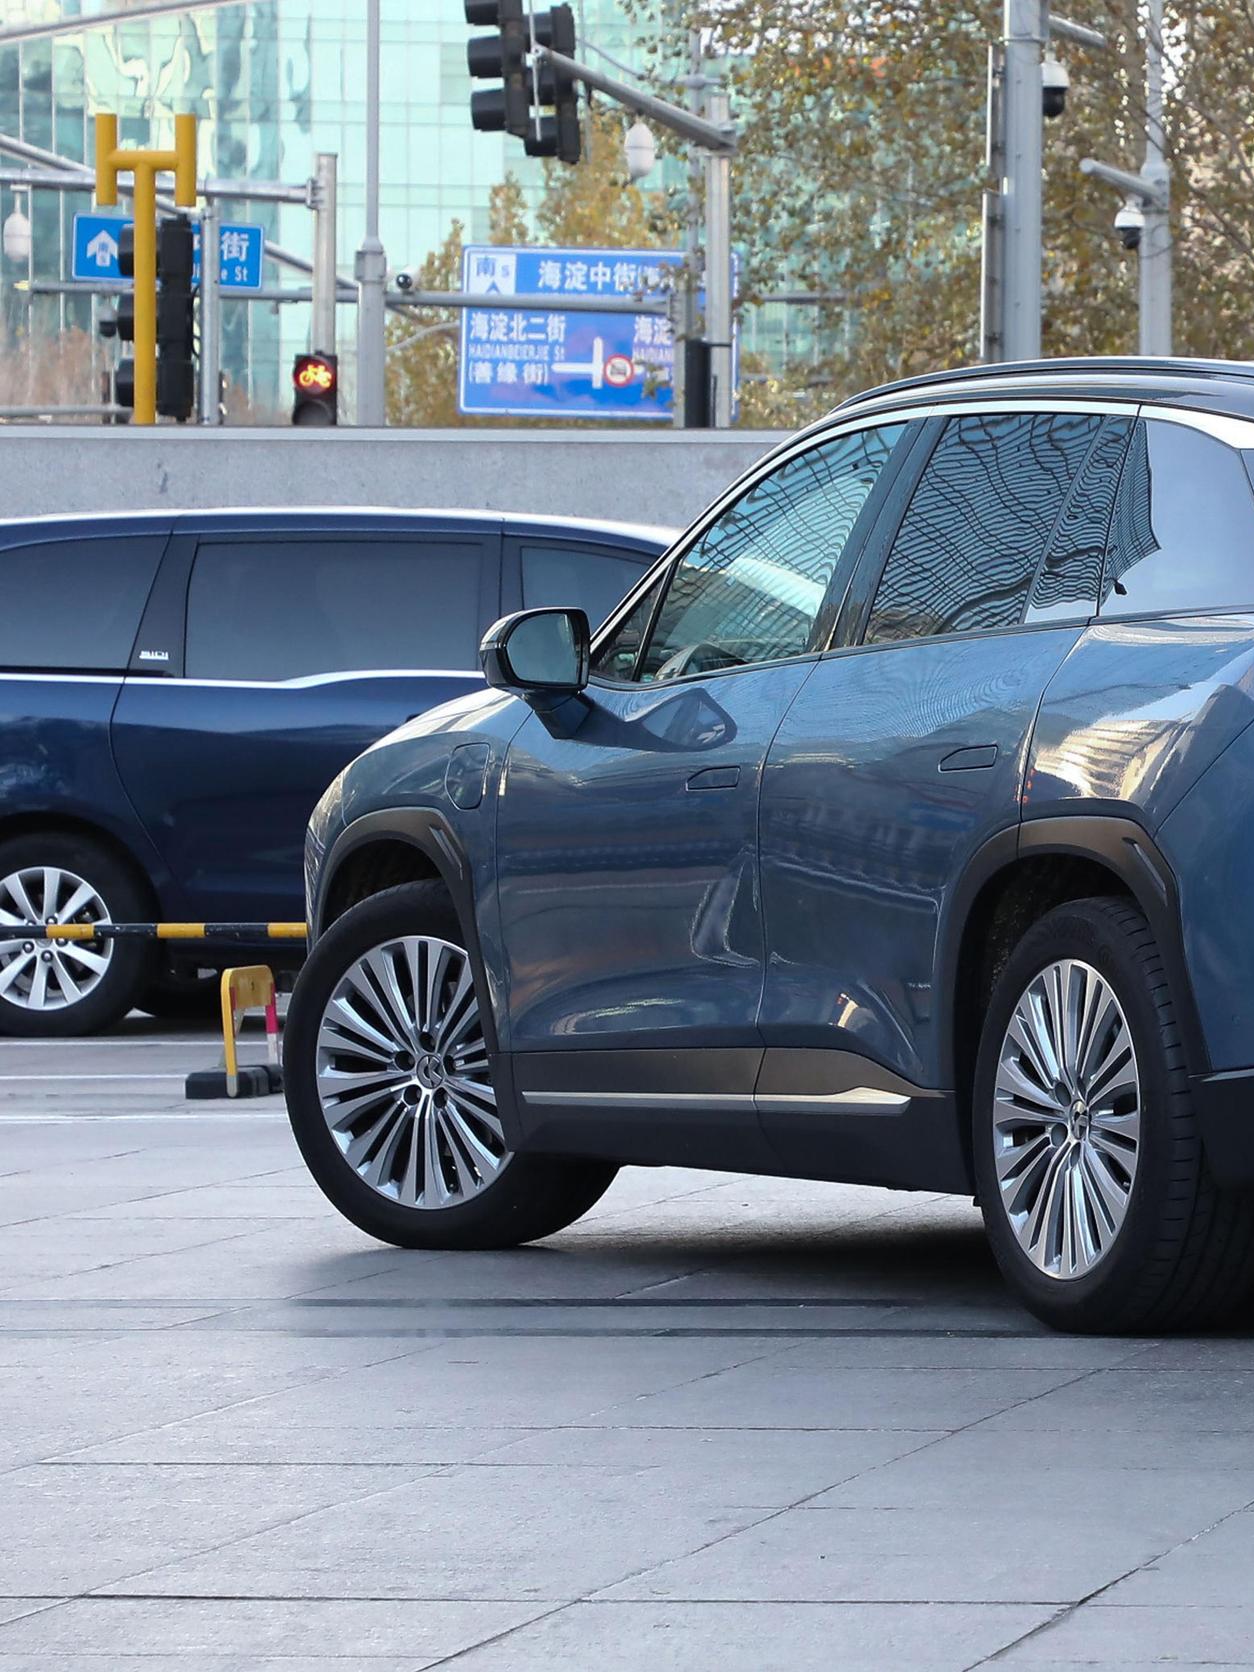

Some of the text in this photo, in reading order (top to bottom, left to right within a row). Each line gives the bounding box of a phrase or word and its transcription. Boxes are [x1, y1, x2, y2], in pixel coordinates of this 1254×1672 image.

[470, 312, 566, 342] 海淀北二街
